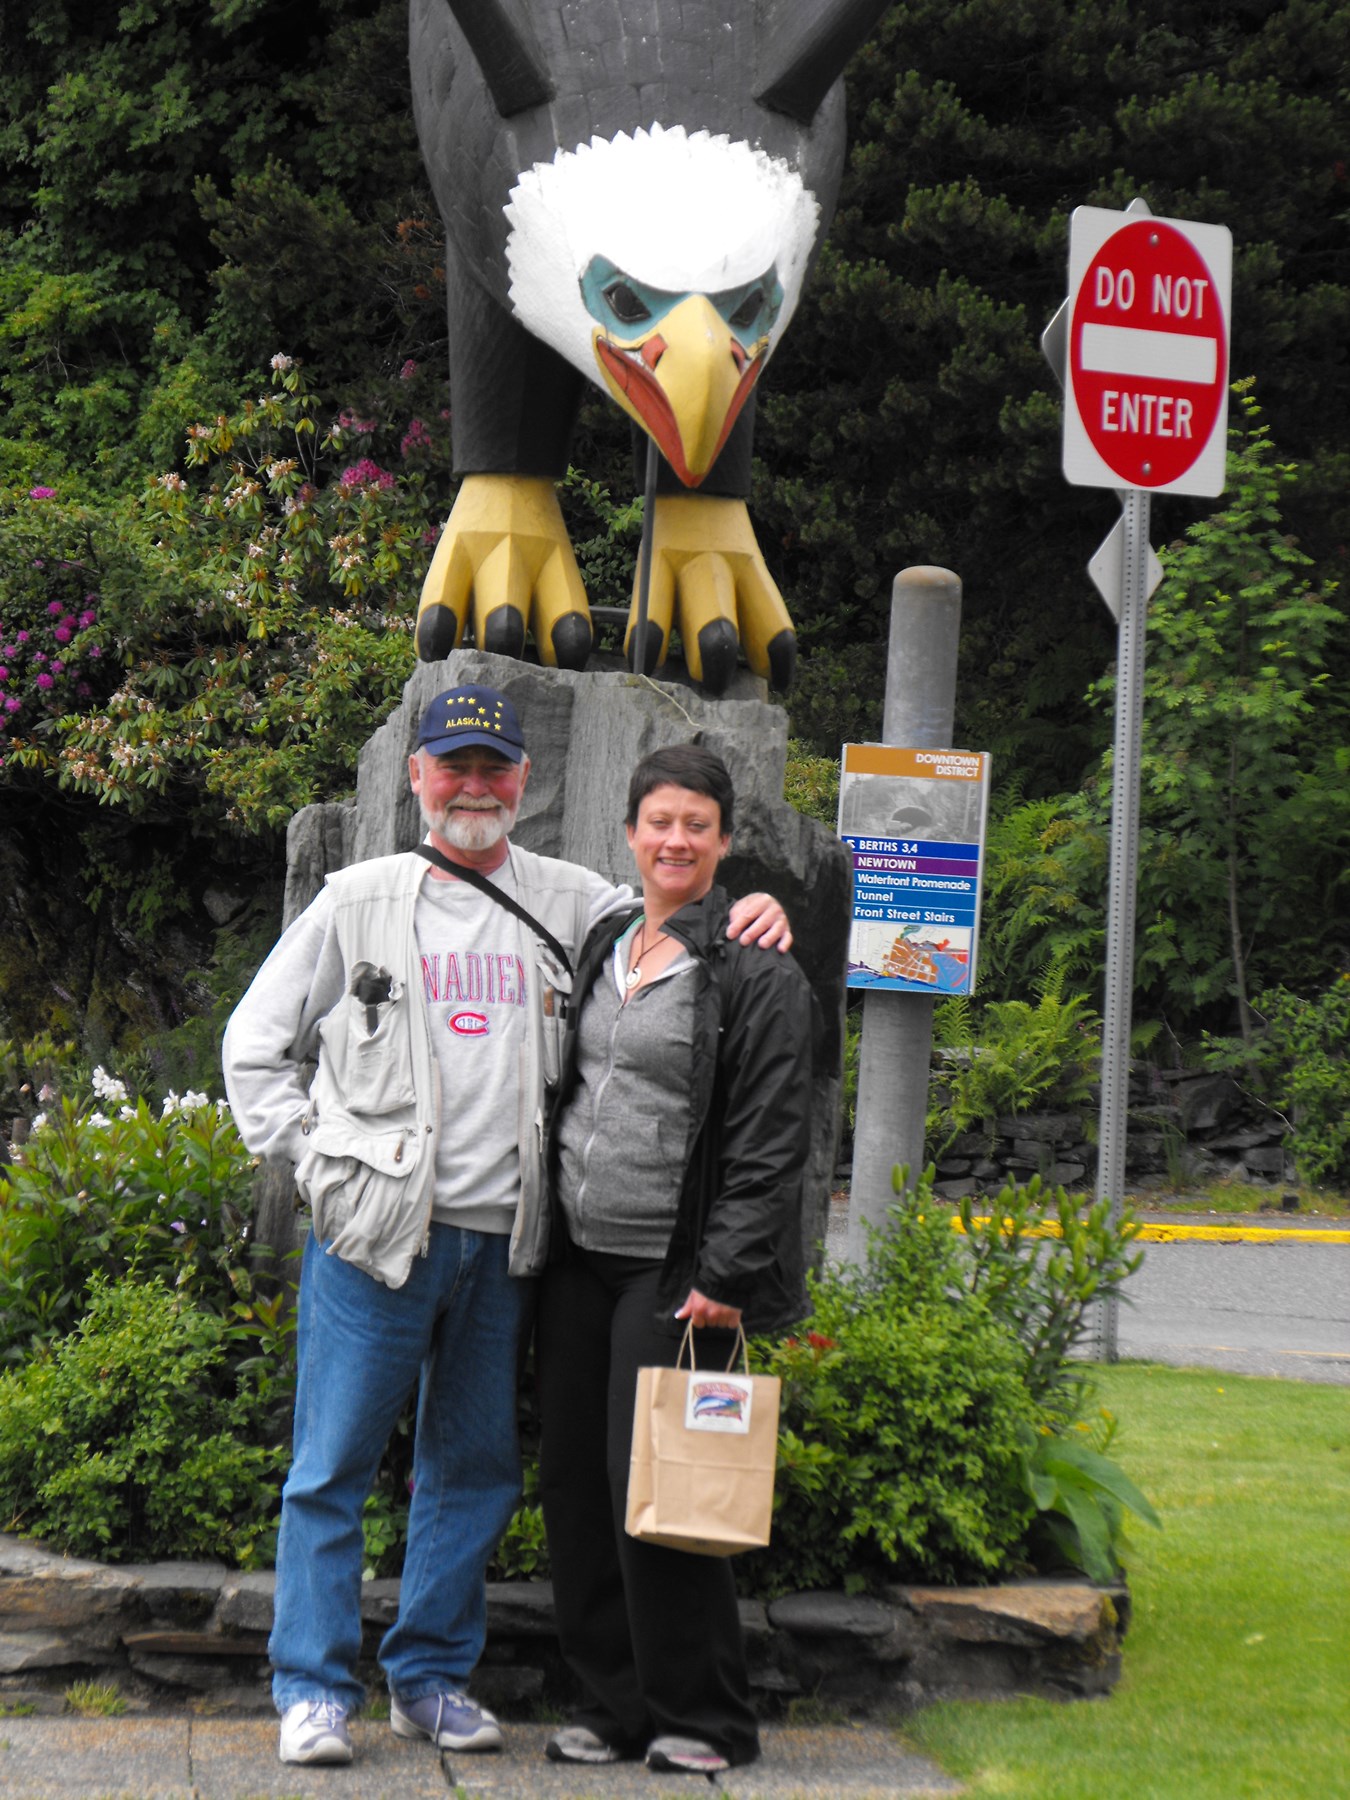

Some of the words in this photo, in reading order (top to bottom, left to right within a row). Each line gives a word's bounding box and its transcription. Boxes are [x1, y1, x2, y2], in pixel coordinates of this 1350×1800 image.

[1095, 265, 1136, 311] DO
[1152, 273, 1208, 320] NOT
[1101, 390, 1193, 439] ENTER
[445, 717, 481, 729] ALASKA
[916, 753, 979, 766] DOWNTOWN
[935, 765, 979, 777] DISTRICT
[859, 839, 898, 852] BERTHS
[901, 842, 918, 854] 3,4
[858, 856, 916, 869] NEWTOWN
[857, 873, 910, 887] Waterfront
[912, 877, 970, 890] Promenade
[856, 889, 894, 902] Tunnel
[854, 906, 884, 918] Front
[886, 908, 921, 921] Street
[923, 911, 955, 923] Stairs
